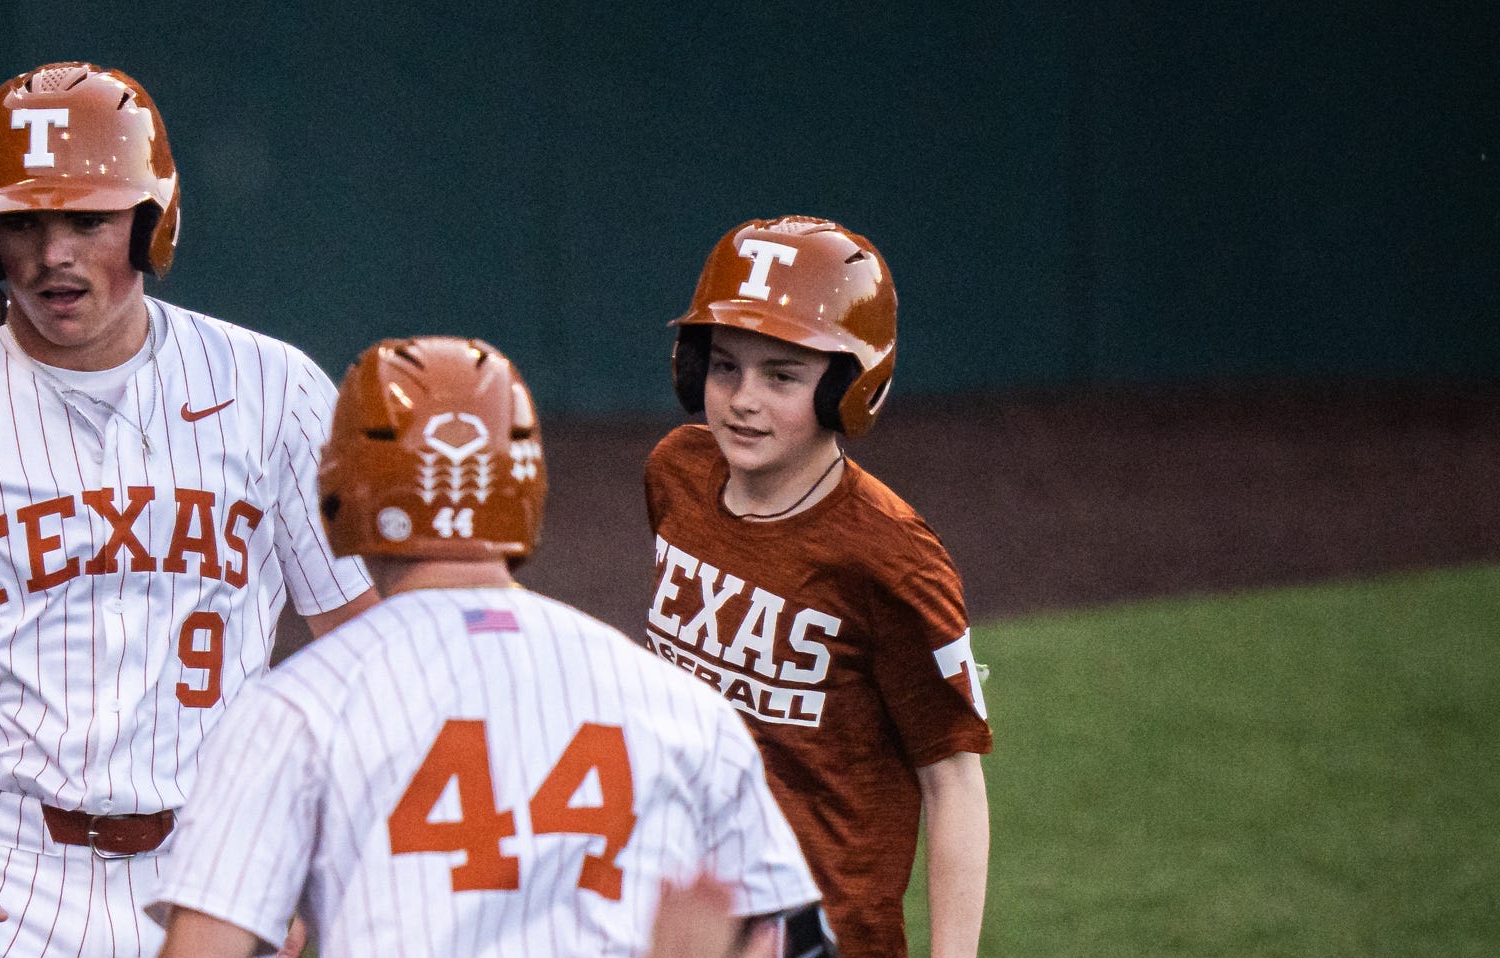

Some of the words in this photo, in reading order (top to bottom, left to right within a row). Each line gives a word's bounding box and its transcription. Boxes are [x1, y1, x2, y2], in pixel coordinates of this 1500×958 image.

[11, 108, 69, 168] T
[738, 239, 798, 301] T
[432, 507, 475, 538] 44
[176, 611, 226, 709] 9
[388, 719, 638, 901] 44
